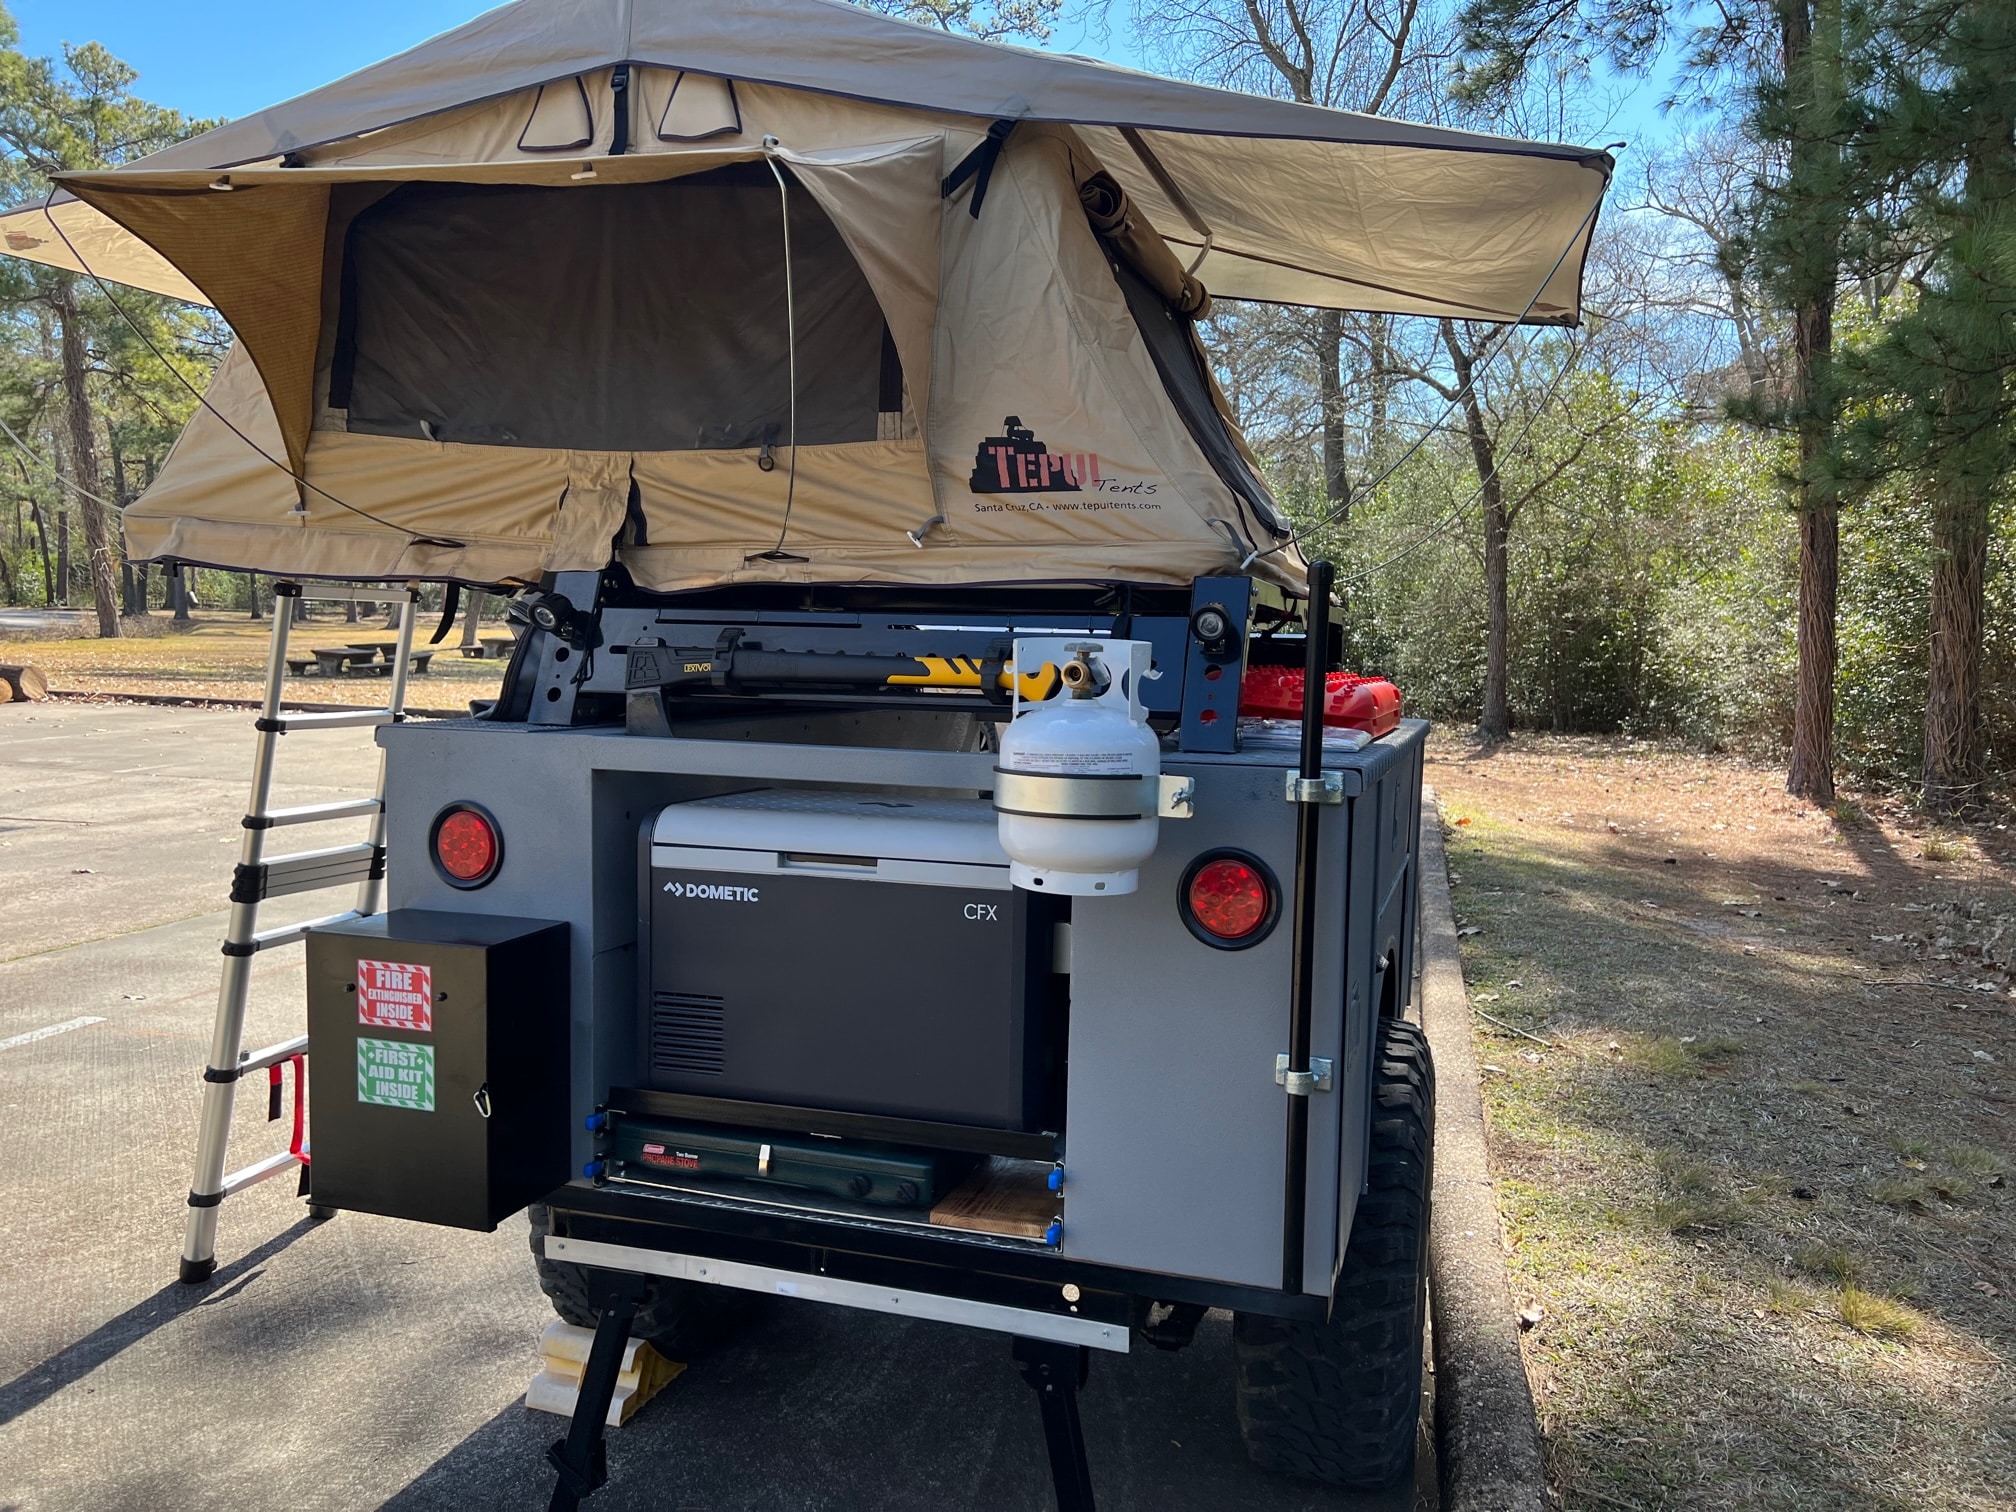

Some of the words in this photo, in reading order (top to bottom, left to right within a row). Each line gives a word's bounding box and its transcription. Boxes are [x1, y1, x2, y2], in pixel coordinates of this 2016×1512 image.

[988, 446, 1100, 488] TEPUI
[1094, 478, 1158, 495] Tents
[975, 503, 1004, 513] Santa
[1052, 501, 1161, 512] www.tepuitents.com
[686, 883, 759, 902] DOMETIC
[963, 903, 998, 921] CFX
[376, 969, 413, 991] FIRE
[368, 988, 423, 1005] EXTINGUISHER
[376, 1002, 414, 1021] INSIDE
[375, 1049, 418, 1067] FIRST
[368, 1064, 395, 1080] AID
[398, 1068, 424, 1084] KIT
[376, 1081, 418, 1100] INSIDE
[642, 1153, 675, 1167] PROPANE
[675, 1157, 699, 1169] STOVE
